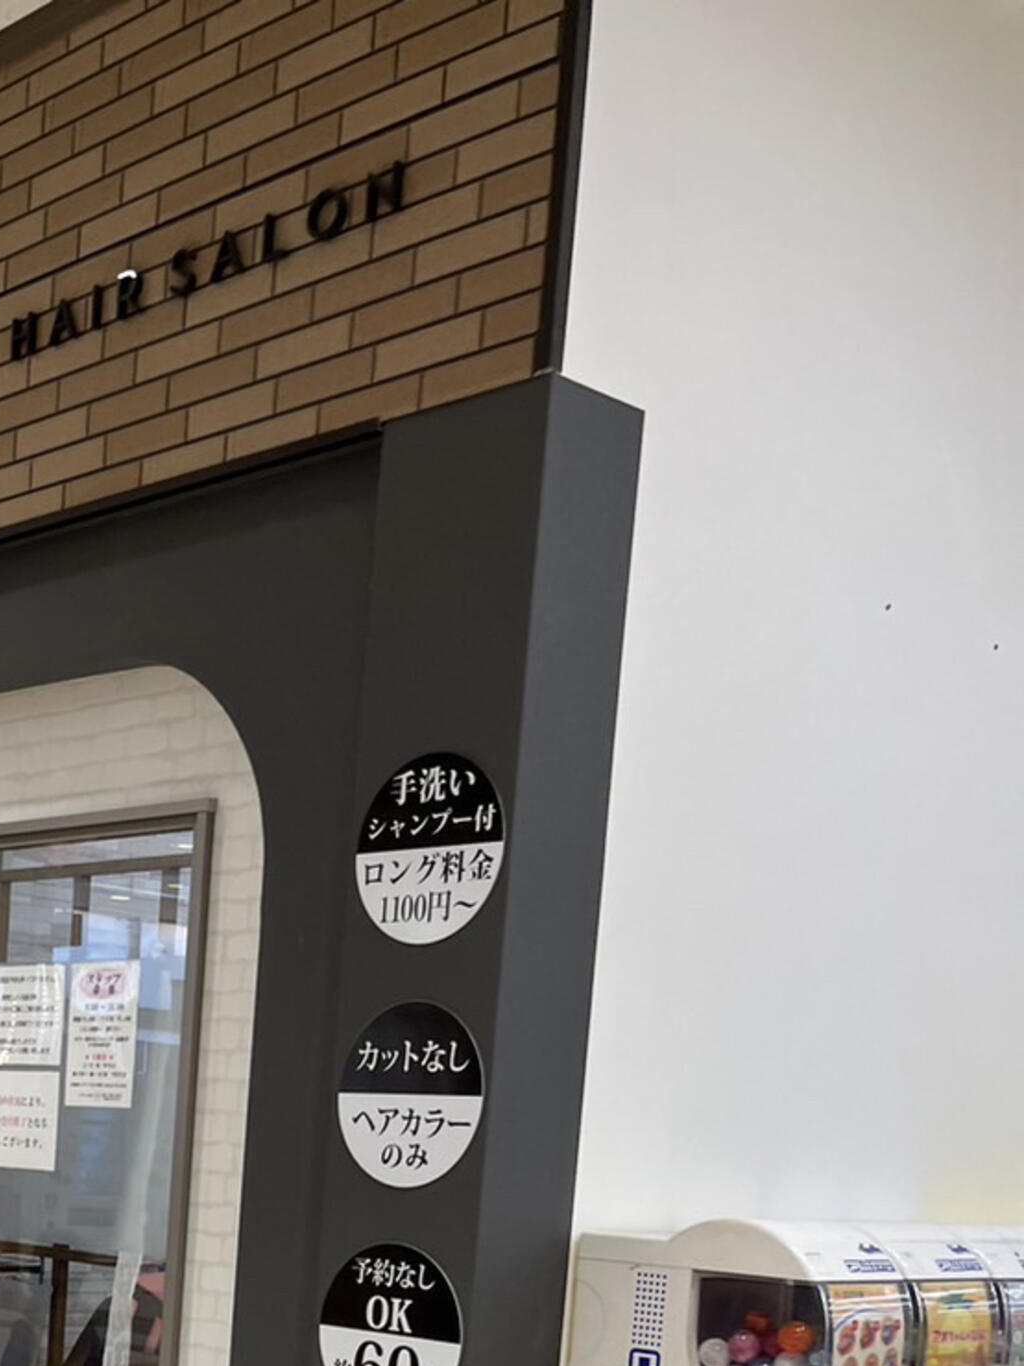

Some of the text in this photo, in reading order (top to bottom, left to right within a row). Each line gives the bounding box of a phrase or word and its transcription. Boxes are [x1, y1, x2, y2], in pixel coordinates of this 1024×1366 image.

[10, 160, 405, 362] HAIR SALON
[391, 765, 476, 806] 手洗い
[368, 803, 496, 840] シャンプー付
[364, 848, 494, 885] ロング料金
[356, 1040, 470, 1073] カットなし
[352, 1107, 471, 1138] ヘアカラー
[381, 1143, 428, 1170] のみ
[352, 1257, 436, 1290] 予約なし
[365, 1295, 413, 1334] OK
